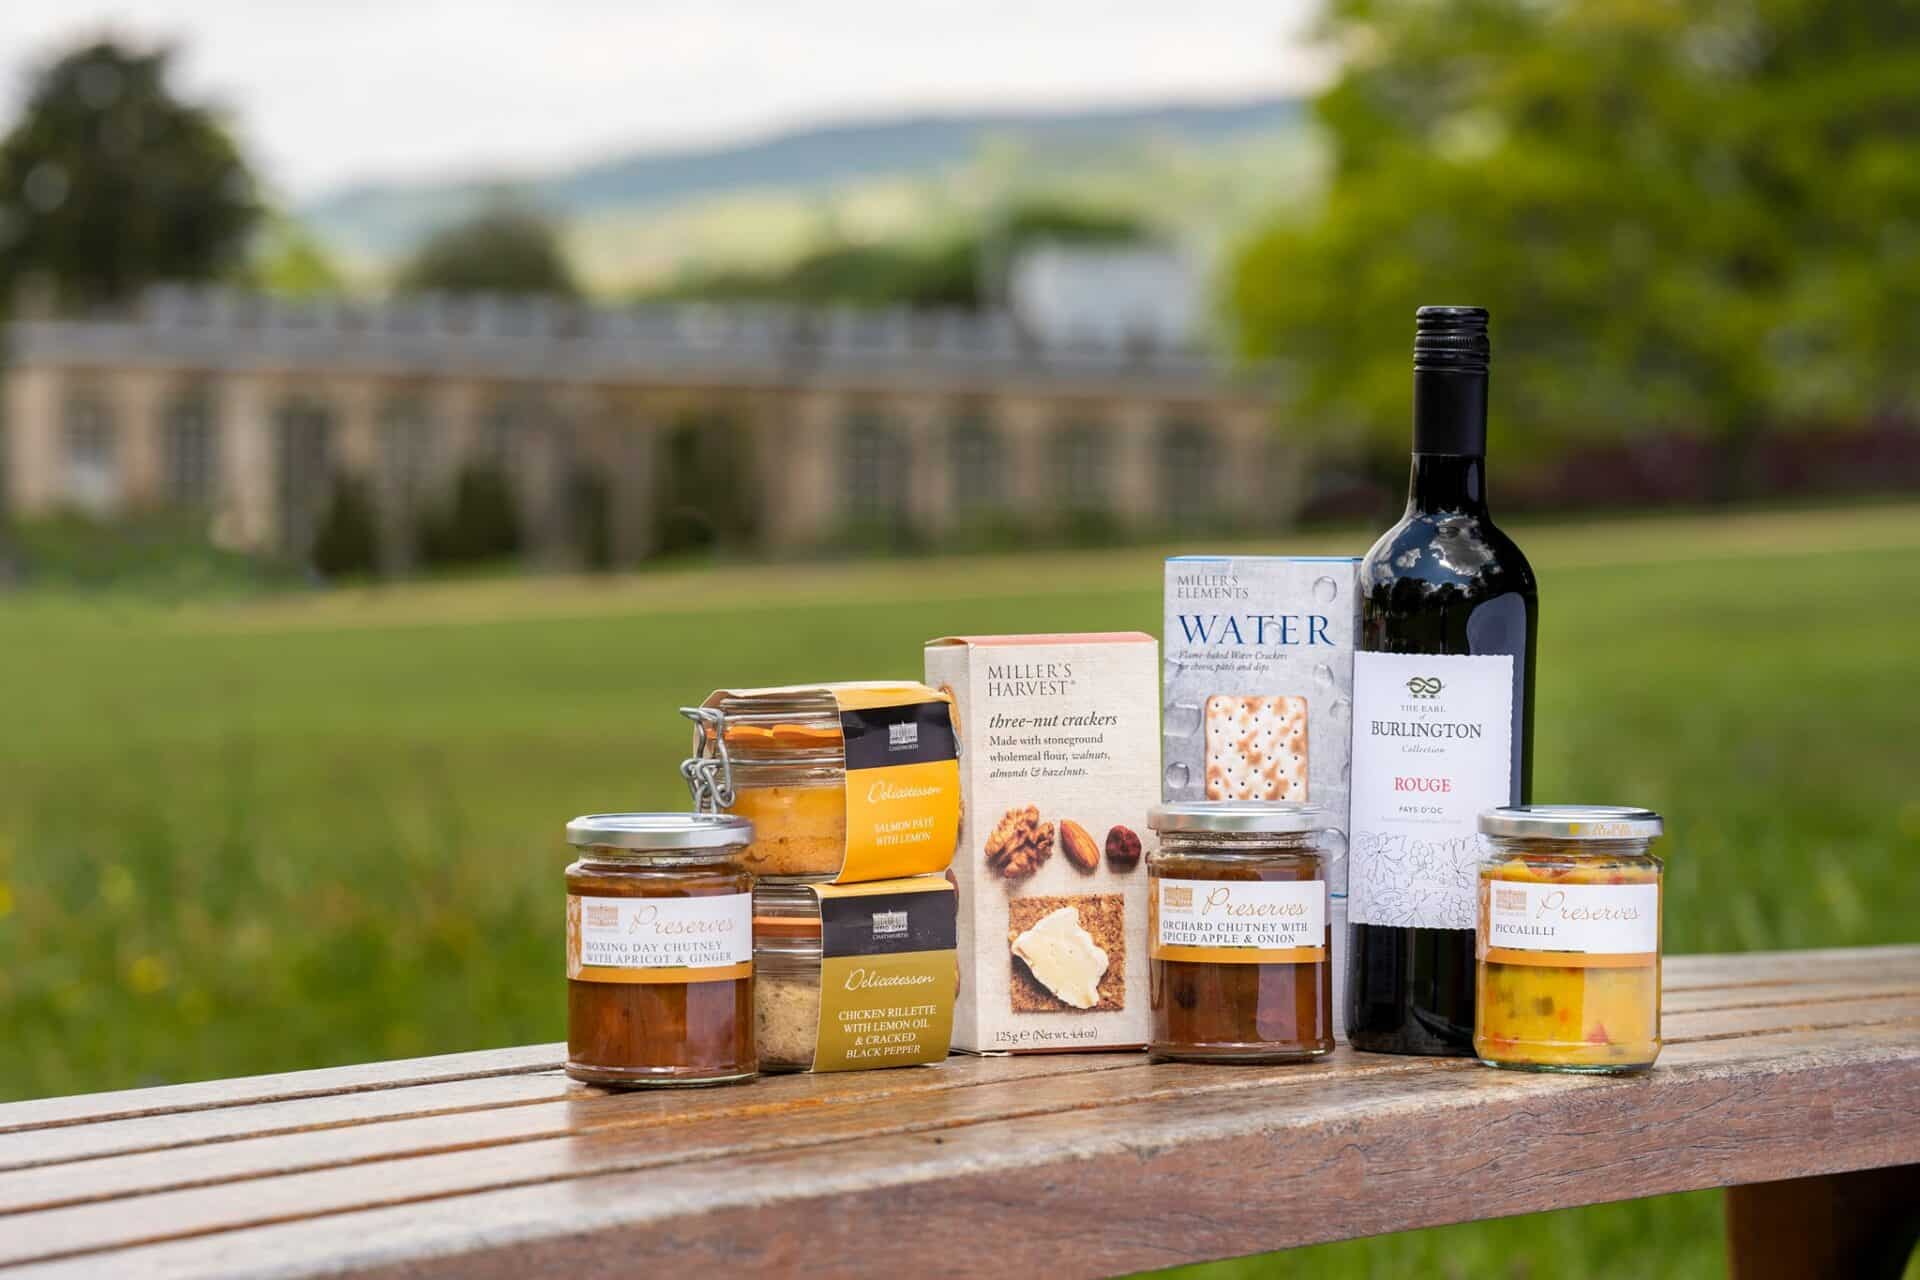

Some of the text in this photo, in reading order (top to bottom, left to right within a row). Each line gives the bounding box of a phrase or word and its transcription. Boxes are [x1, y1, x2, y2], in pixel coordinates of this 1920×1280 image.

[1177, 574, 1239, 586] MILLER'S
[1177, 587, 1249, 600] ELEMENTS
[1177, 614, 1336, 646] WATER
[1255, 648, 1288, 660] Crackers
[988, 663, 1072, 680] MILLER'S
[1236, 662, 1252, 671] and
[1400, 704, 1418, 712] THE
[989, 712, 1118, 728] three-nut crackers
[1371, 721, 1482, 738] BURLINGTON
[990, 734, 1104, 748] Made with stoneground
[1401, 744, 1446, 754] Collection
[990, 750, 1111, 762] wholemeal flour, walnuts,
[990, 766, 1088, 778] almonds & hazelnuts.
[1395, 777, 1452, 792] ROUGE
[867, 780, 942, 804] Delicatessen
[1399, 805, 1418, 813] PAYS
[874, 820, 910, 833] SALMON
[876, 831, 932, 846] WITH LEMON
[1202, 887, 1308, 916] Preserves
[1536, 890, 1640, 920] Preserves
[628, 904, 736, 935] Preserves
[1163, 920, 1308, 932] ORCHARD CHUTNEY WITH
[1495, 924, 1556, 936] PICCALILLI
[1163, 933, 1295, 944] SPICED APPLE & ONION
[586, 940, 722, 953] BOXING DAY CHUTNEY
[586, 952, 733, 964] WITH APRICOT & GINGER
[844, 968, 935, 992] Delicatessen
[838, 1004, 937, 1021] CHICKEN RILLETTE
[844, 1018, 930, 1033] WITH LEMON OIL
[855, 1032, 916, 1046] & CRACKED
[995, 1031, 1018, 1044] 125g
[846, 1045, 921, 1059] BLACK PEPPER
